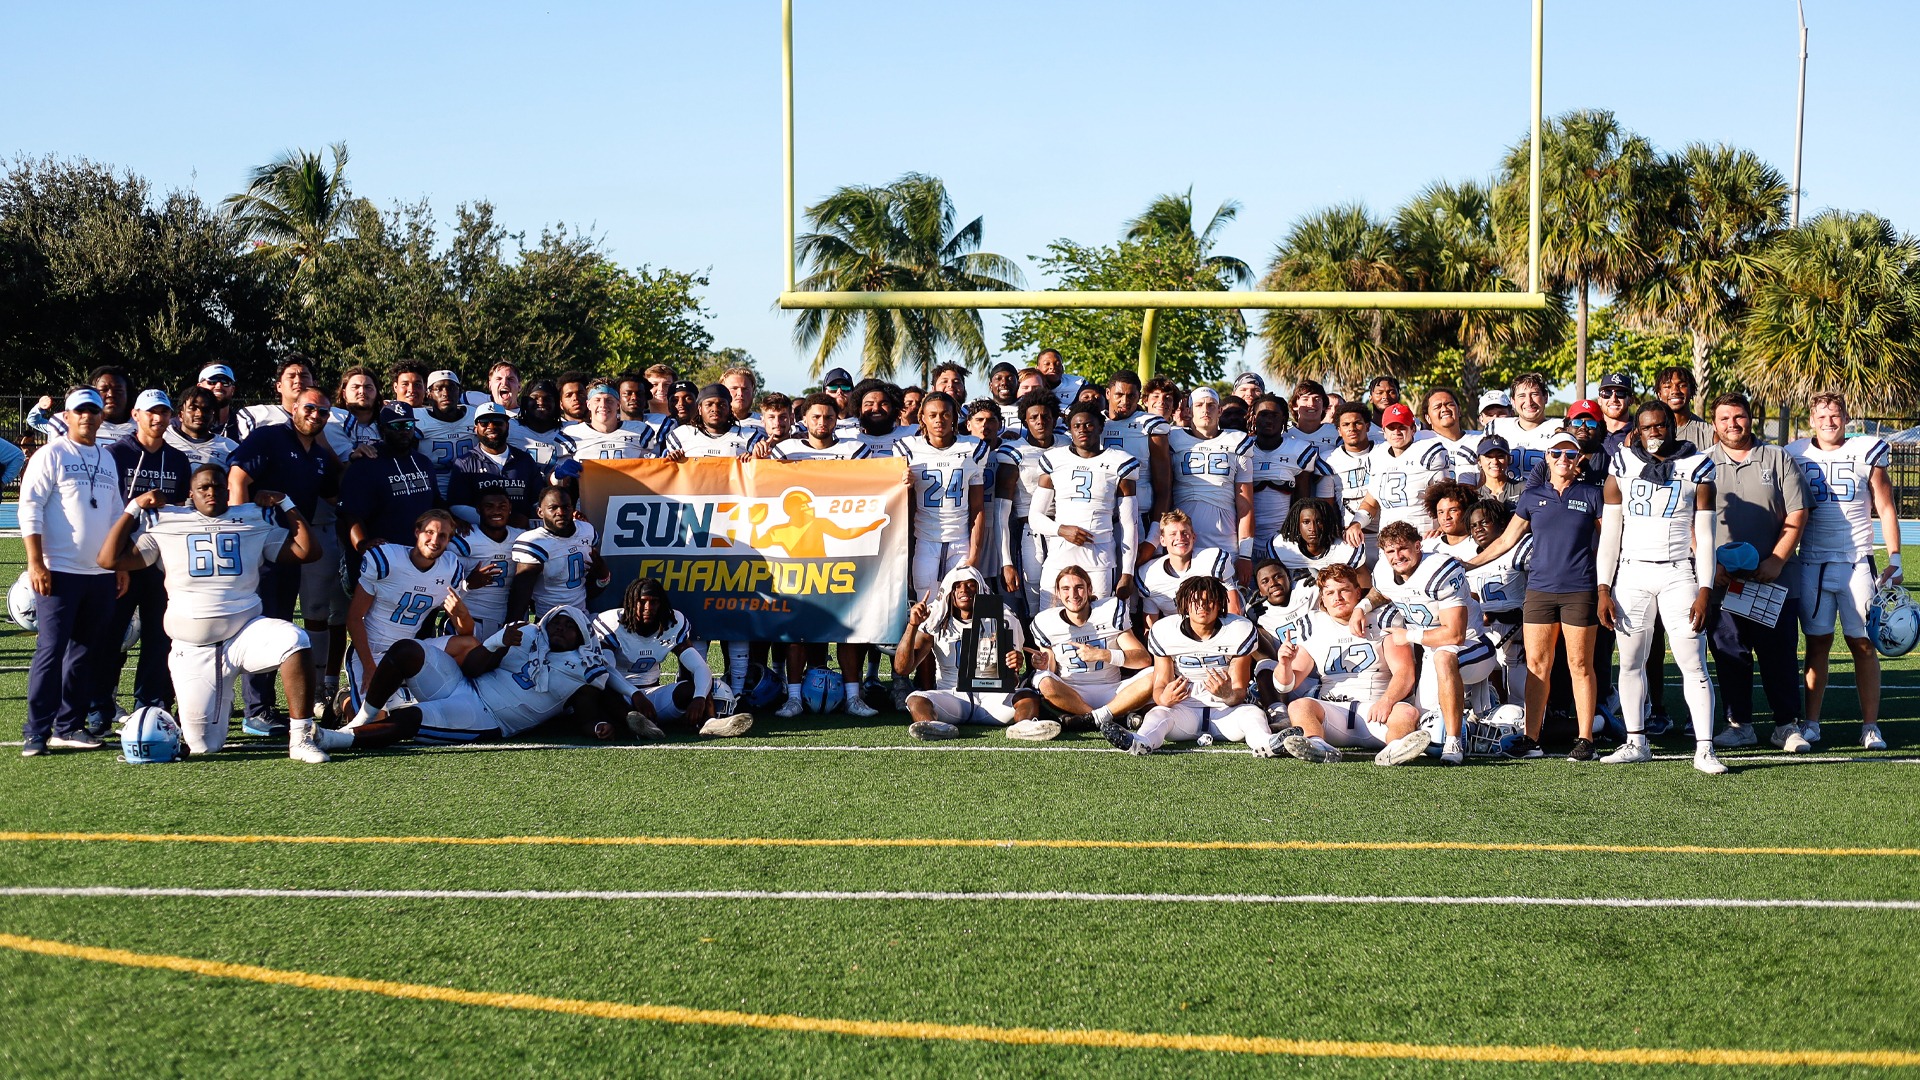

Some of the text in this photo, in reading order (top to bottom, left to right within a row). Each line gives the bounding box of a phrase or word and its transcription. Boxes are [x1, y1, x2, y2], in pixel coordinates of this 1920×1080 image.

[127, 468, 177, 480] FOOTBALL
[388, 470, 429, 484] FOOTBALL
[1180, 451, 1230, 476] 22
[478, 479, 526, 489] FOOTBALL
[921, 468, 964, 508] 24
[1071, 470, 1093, 503] 3
[1628, 478, 1682, 519] 87
[1805, 461, 1856, 502] 35
[613, 499, 879, 548] SUN 2023
[186, 533, 243, 577] 69
[639, 559, 857, 595] CHAMPIONS
[390, 591, 434, 626] 19
[704, 597, 791, 613] FOOTBALL
[1061, 637, 1108, 673] 37
[1323, 642, 1377, 675] 42
[131, 744, 151, 757] 69
